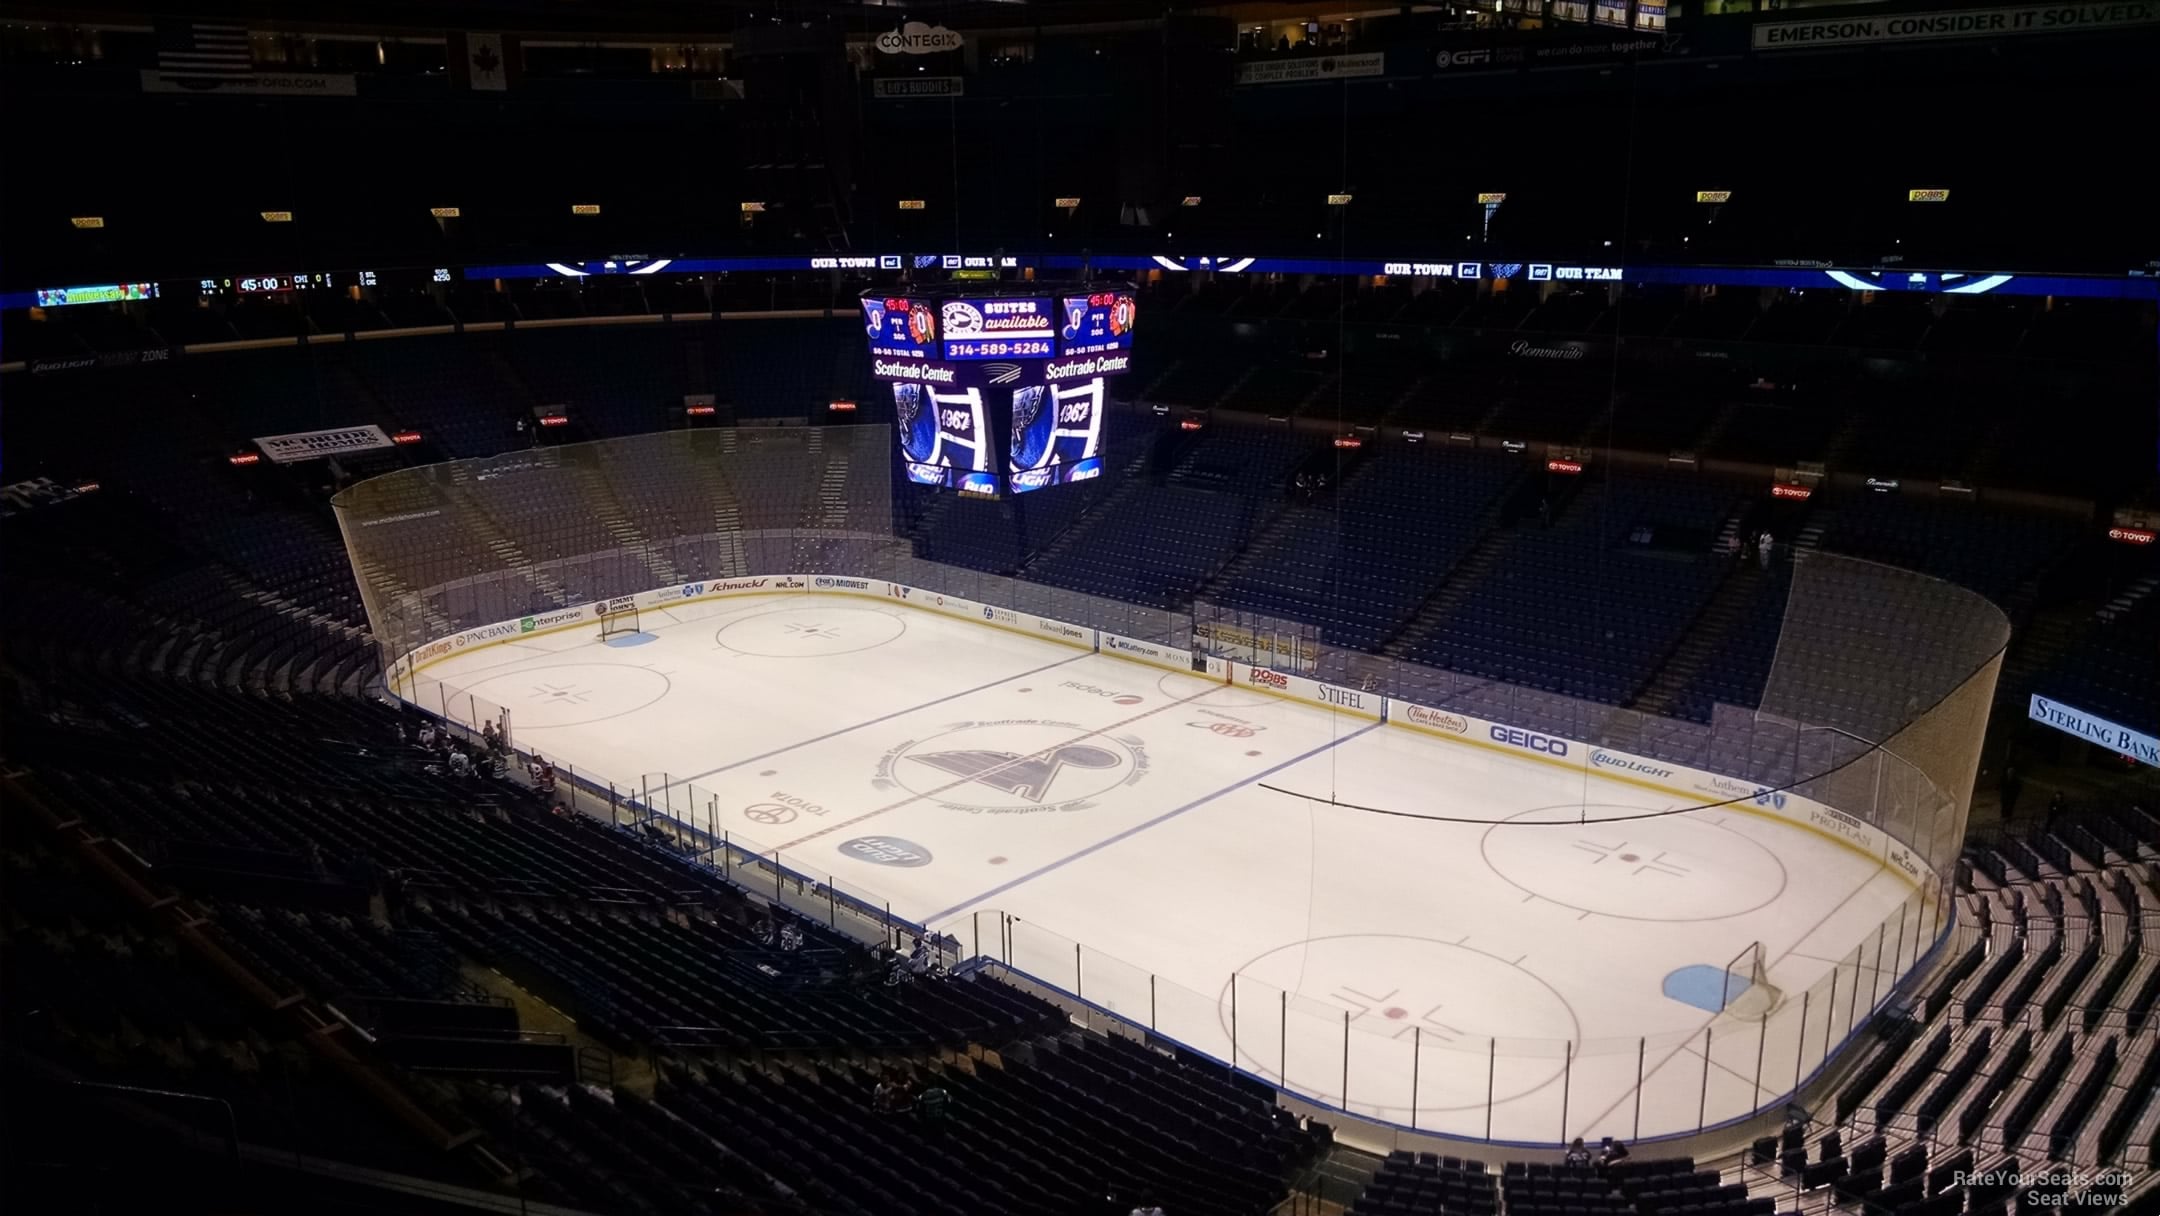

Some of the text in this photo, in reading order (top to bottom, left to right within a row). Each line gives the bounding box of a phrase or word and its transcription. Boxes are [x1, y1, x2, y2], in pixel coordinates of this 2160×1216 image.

[1767, 4, 2152, 43] EMERSON. CONSIDER IT SOLVED.
[881, 34, 956, 48] CONTEGIX
[1611, 40, 1656, 54] together
[1915, 190, 1945, 199] DOBBS
[811, 257, 876, 269] OUR TOWN
[964, 257, 983, 267] OUR
[984, 257, 1017, 266] TAM
[1384, 263, 1453, 276] OUR TOWN
[201, 280, 218, 288] STL
[224, 278, 231, 287] 0
[241, 278, 279, 291] 45:00
[294, 275, 309, 283] CHI
[315, 274, 322, 282] 0
[1556, 267, 1583, 279] OUR
[1584, 268, 1623, 280] TEAM
[886, 298, 909, 311] 45:00
[984, 302, 1037, 314] SUITES
[1090, 294, 1114, 307] 45:00
[871, 309, 882, 331] 0
[916, 311, 927, 334] 0
[985, 315, 1049, 329] available
[1072, 308, 1081, 330] 0
[1091, 313, 1104, 321] PER
[1118, 303, 1127, 325] 0
[893, 349, 911, 357] TOTAL
[949, 342, 1049, 356] 314-589-5284
[1087, 344, 1105, 353] TOTAL
[1508, 340, 1584, 360] Bommarito
[62, 359, 95, 369] LIGHT
[141, 349, 168, 362] ZONE
[1046, 356, 1128, 380] Scottrade Center
[875, 360, 954, 382] Scottrade Center
[941, 408, 971, 430] 1967
[1059, 401, 1090, 423] 1967
[911, 468, 945, 485] LIGHT
[1557, 464, 1582, 472] TOYOTA
[1013, 473, 1050, 486] LIGHT
[708, 578, 769, 593] Schnucks
[775, 581, 804, 589] NHL.COM
[835, 579, 869, 590] MIDWEST
[609, 594, 635, 607] JIMMY
[524, 610, 581, 630] enterprise
[466, 623, 517, 643] PNC BANK
[415, 641, 453, 663] DraftKings
[1249, 668, 1288, 686] DOBBS
[1317, 683, 1365, 710] STIFEL
[977, 718, 1039, 728] Scottrade
[1412, 706, 1463, 728] Tim Hortons
[2035, 699, 2160, 762] STERLING BANK
[1490, 725, 1568, 757] GEICO
[1594, 751, 1674, 779] BUD LIGHT
[1710, 777, 1750, 795] Anthem
[770, 791, 832, 817] TOYOTA
[1810, 811, 1836, 830] PRO
[1837, 822, 1872, 847] PLAN
[852, 843, 899, 862] BUD
[861, 838, 922, 861] LIGHT
[1890, 851, 1919, 876] NHL.COM
